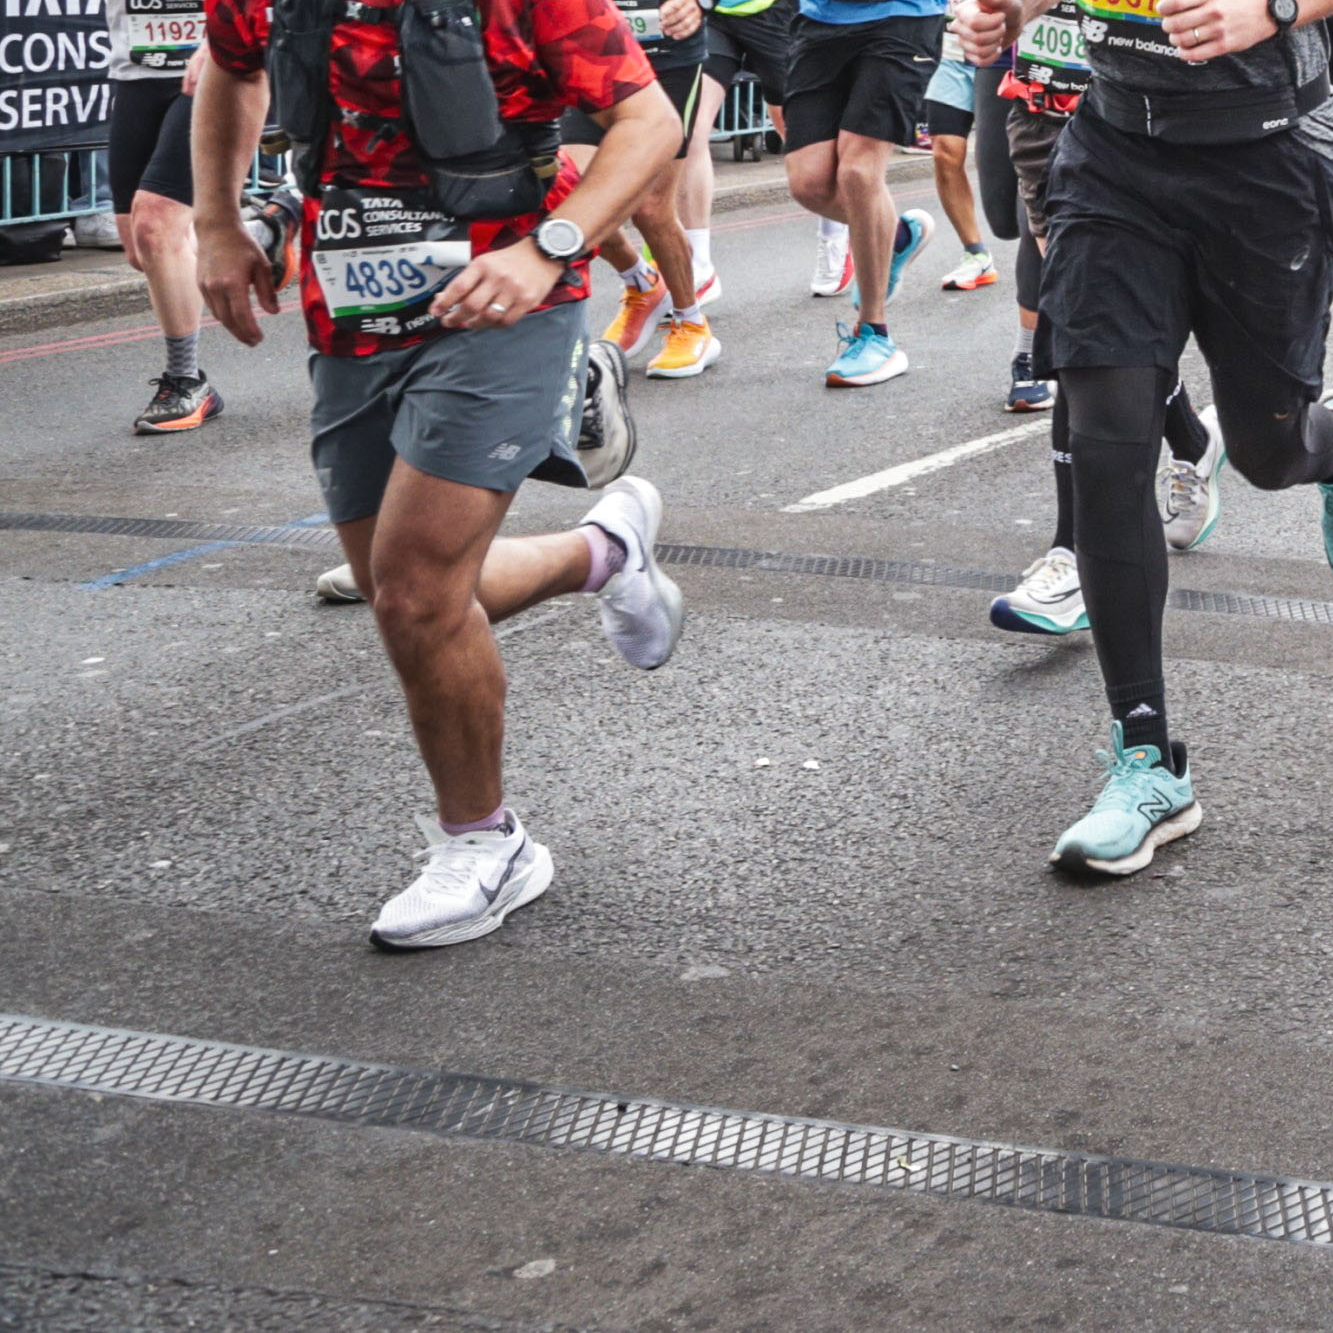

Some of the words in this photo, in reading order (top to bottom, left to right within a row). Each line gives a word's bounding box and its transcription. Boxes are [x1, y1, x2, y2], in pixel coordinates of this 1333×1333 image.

[145, 20, 208, 42] 11927
[1031, 24, 1087, 59] 4098
[0, 30, 111, 74] CONS
[1107, 35, 1134, 48] new
[1135, 38, 1181, 58] balance
[0, 83, 116, 130] SERVI
[360, 197, 403, 209] TATA
[366, 223, 423, 237] SERVICES
[345, 256, 434, 299] 4839
[405, 314, 434, 330] new
